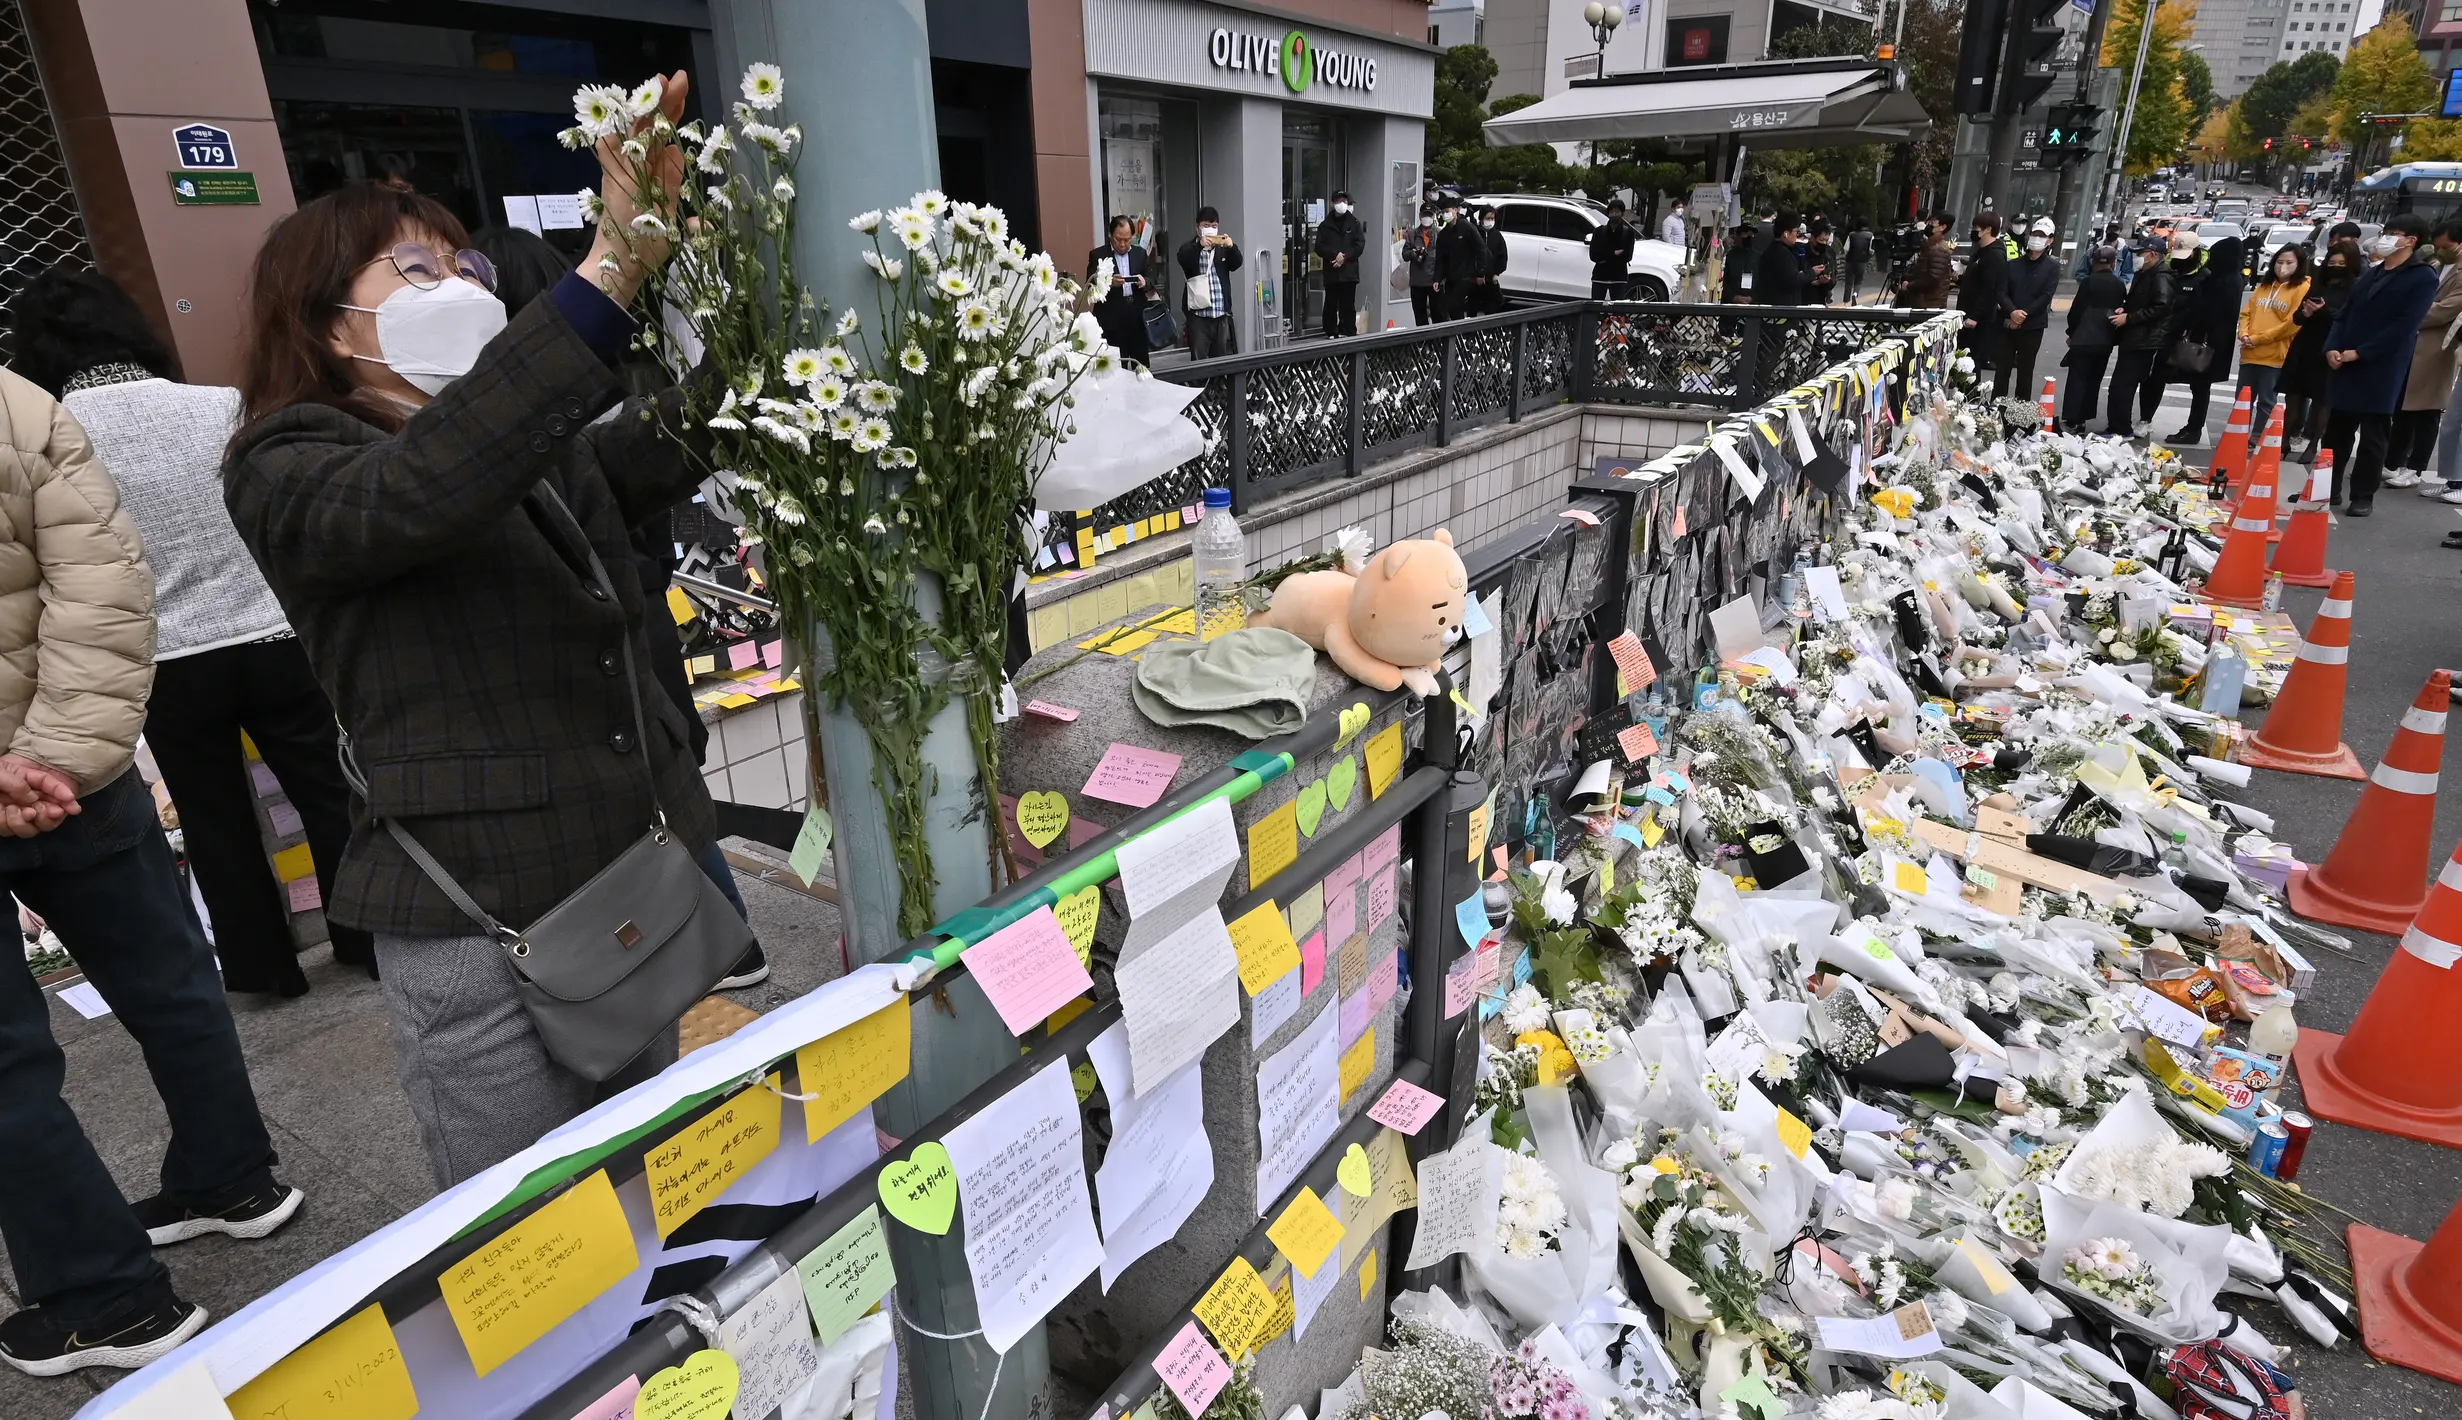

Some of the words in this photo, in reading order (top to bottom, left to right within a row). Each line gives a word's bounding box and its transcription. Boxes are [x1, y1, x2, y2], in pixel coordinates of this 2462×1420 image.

[1210, 28, 1280, 75] OLIVE
[1312, 48, 1377, 91] YOUNG
[1752, 111, 1787, 126] 용산구
[189, 146, 225, 163] 179
[2189, 977, 2213, 998] Nacho
[695, 1159, 735, 1194] 마세요
[890, 1163, 922, 1189] 하늘에서
[481, 1236, 523, 1268] 친구들아
[463, 1272, 506, 1305] 너희들을
[509, 1255, 531, 1271] 잊지
[534, 1232, 565, 1262] 않을게
[844, 1287, 861, 1305] RIP
[322, 1347, 398, 1405] 3/11/2022
